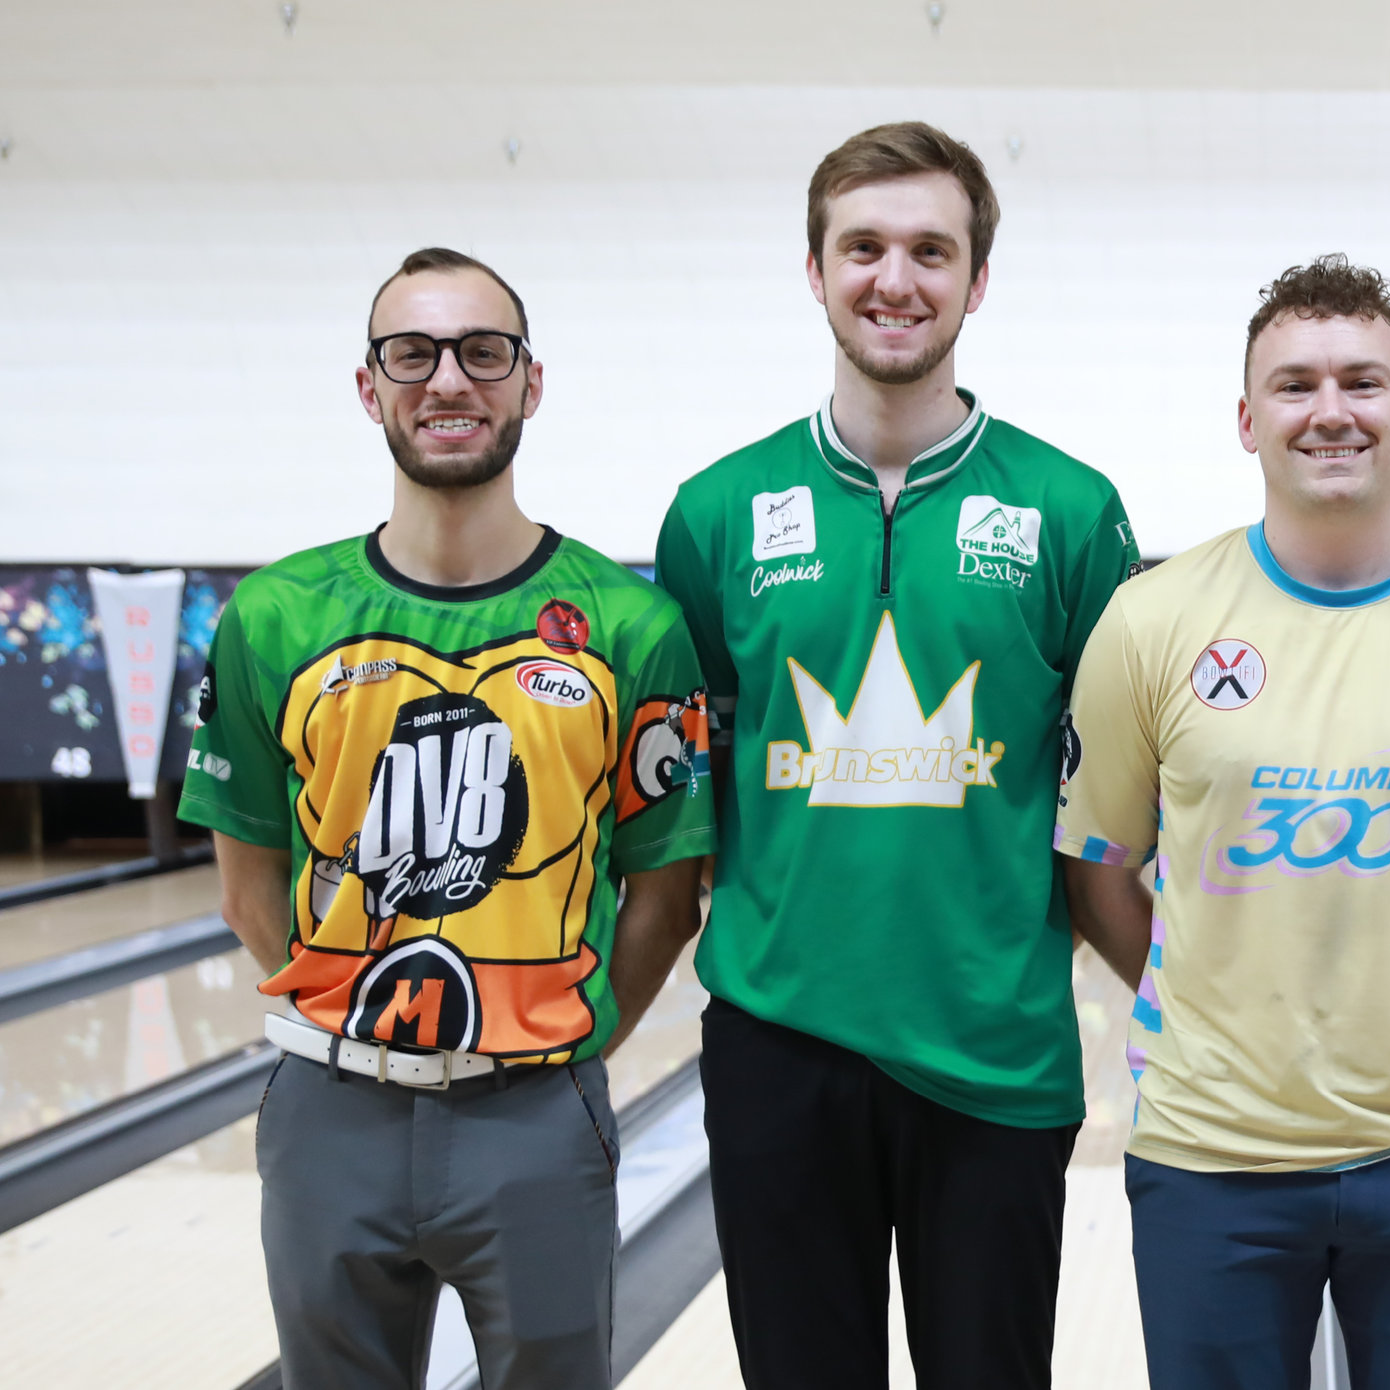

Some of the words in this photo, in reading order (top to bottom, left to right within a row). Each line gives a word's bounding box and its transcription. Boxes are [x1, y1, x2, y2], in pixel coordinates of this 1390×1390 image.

[960, 538, 988, 552] THE
[991, 541, 1035, 564] HOUSE
[750, 557, 825, 597] Coolwick
[957, 553, 1032, 588] Dexter
[531, 671, 586, 702] Turbo
[413, 711, 442, 728] BORN
[445, 707, 469, 721] 2011
[51, 746, 92, 779] 48
[765, 735, 1003, 790] Brunswick
[358, 721, 513, 875] DV8
[379, 842, 487, 907] Bowling
